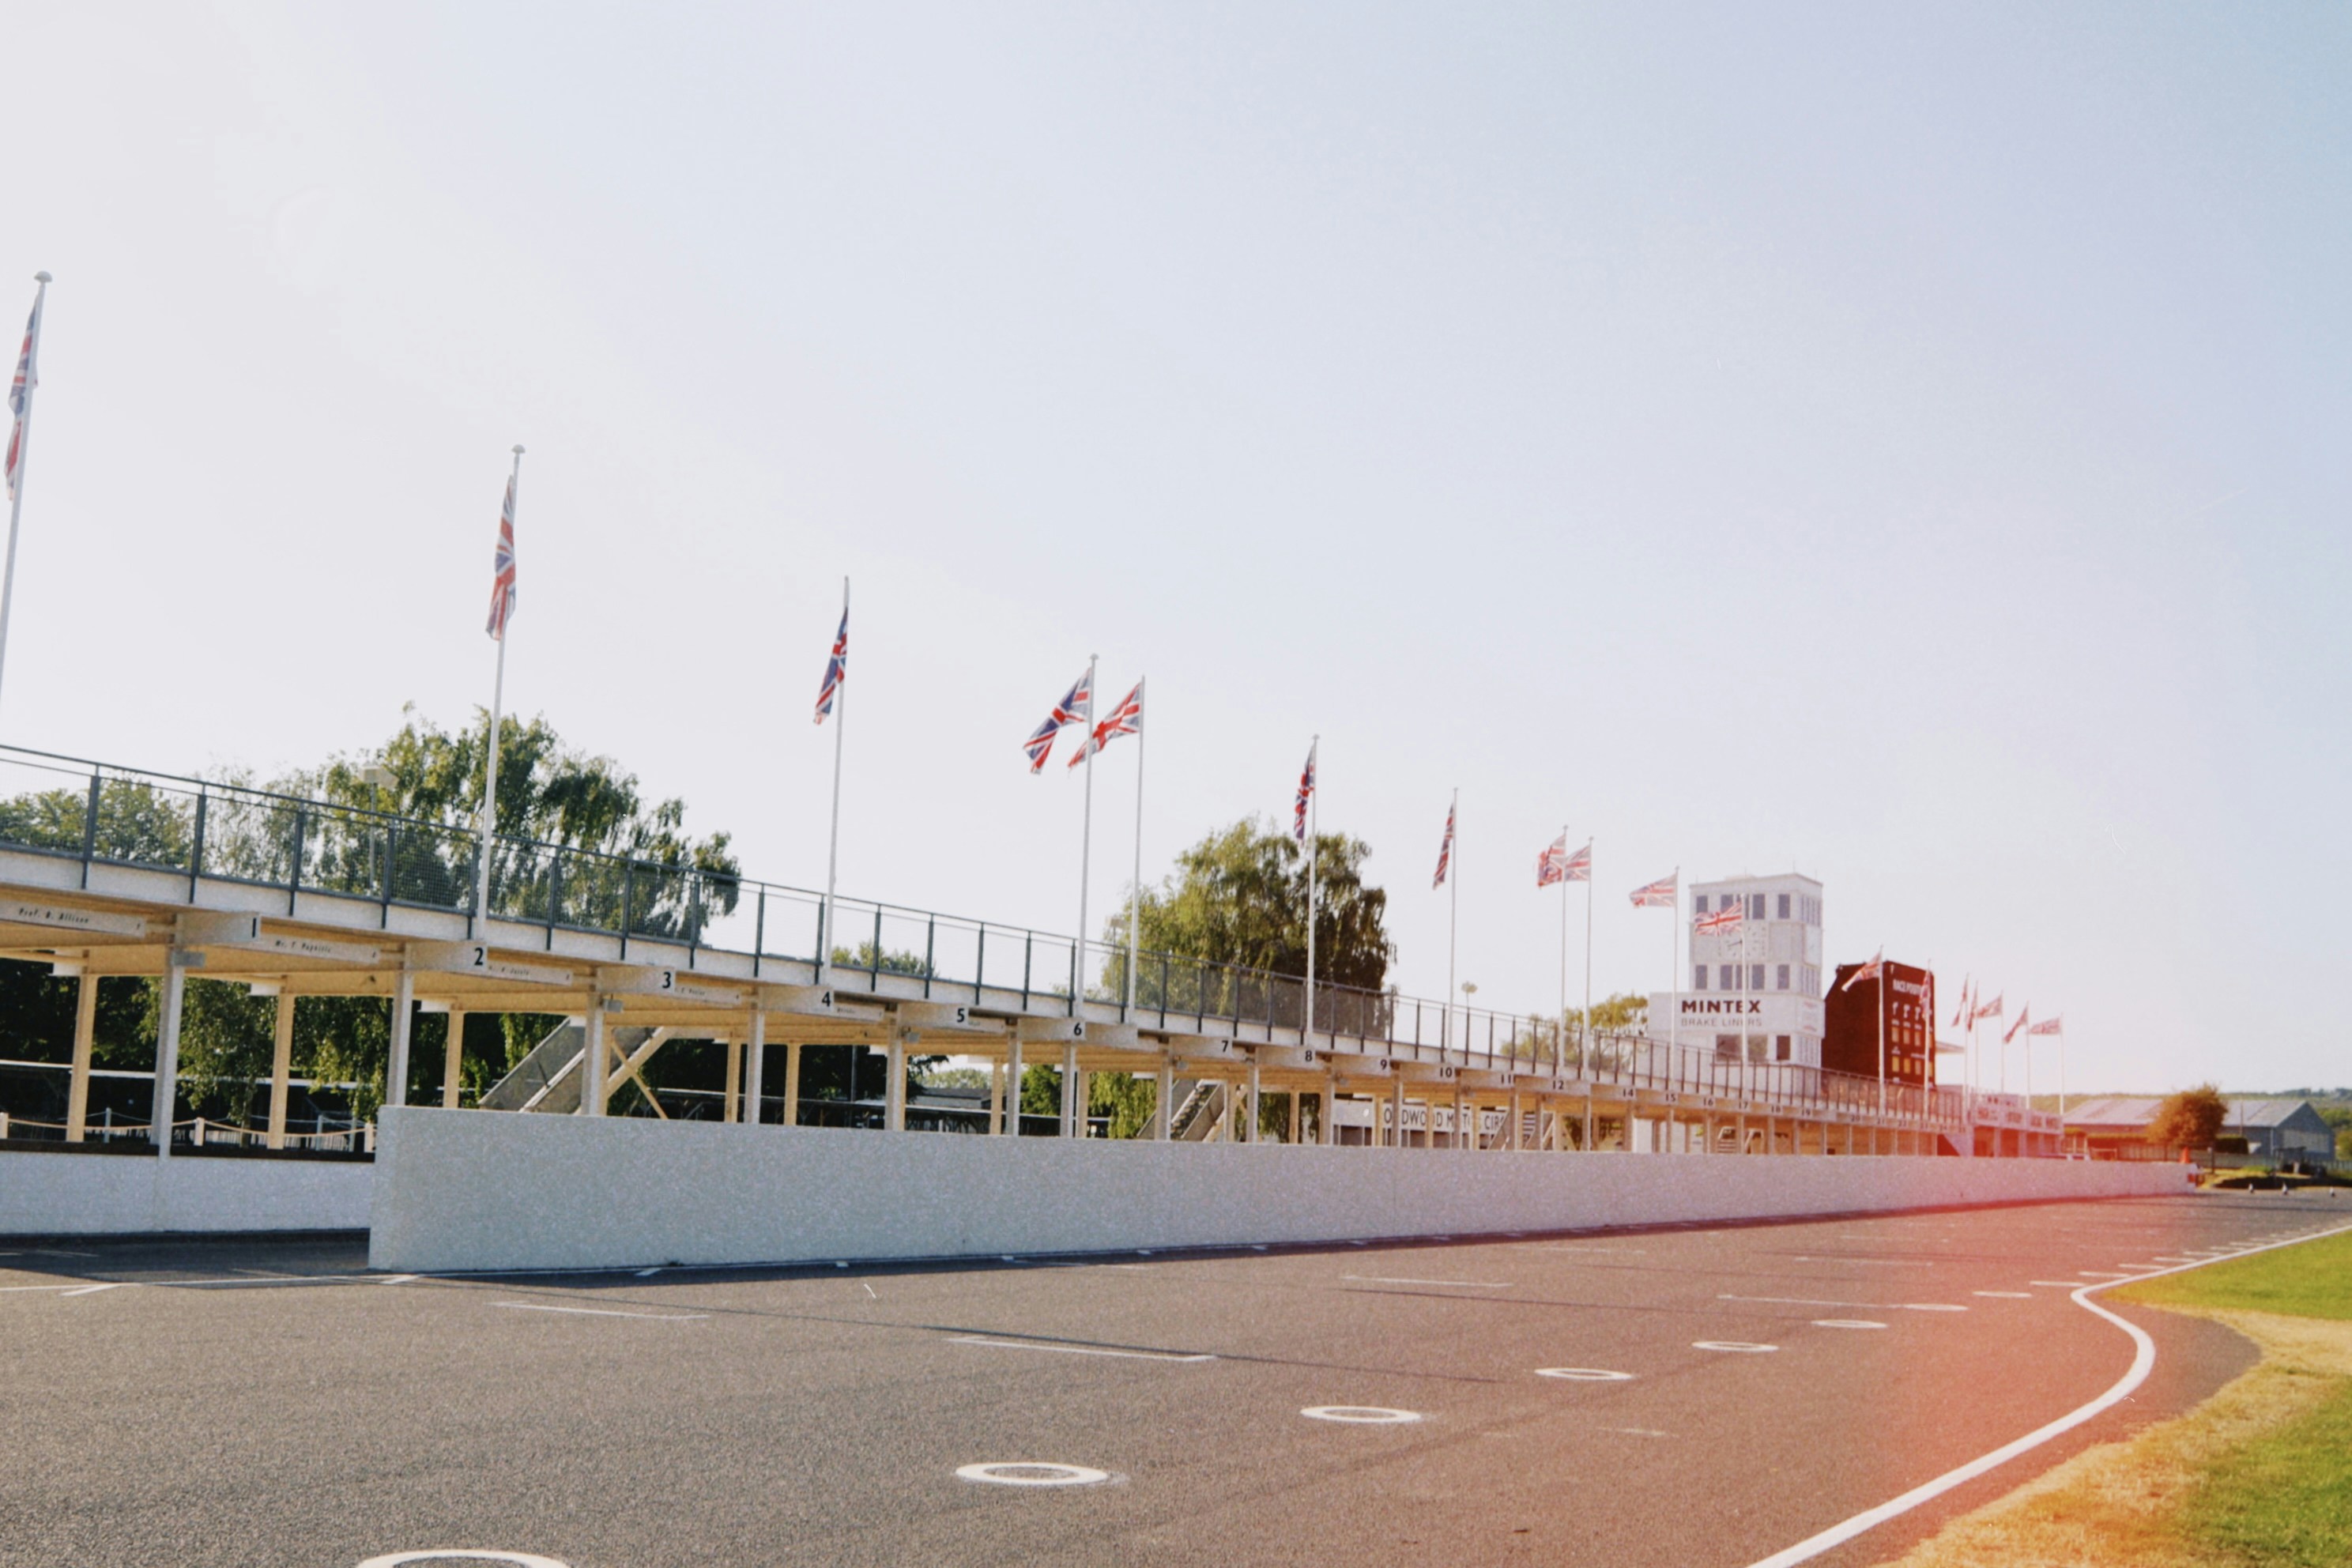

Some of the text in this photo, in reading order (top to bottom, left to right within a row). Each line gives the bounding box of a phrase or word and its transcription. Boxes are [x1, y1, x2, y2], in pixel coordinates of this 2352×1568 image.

[252, 918, 257, 938] 1
[474, 947, 484, 966] 2
[662, 971, 671, 989] 3
[822, 992, 831, 1007] 4
[1682, 1000, 1761, 1013] MINTEX
[957, 1008, 965, 1023] 5
[1682, 1018, 1762, 1027] BRAKE LINRS
[1073, 1023, 1082, 1036] 6
[1222, 1040, 1229, 1053] 7
[1305, 1050, 1313, 1062] 8
[1380, 1059, 1387, 1070] 9
[1440, 1067, 1453, 1078] 10
[1552, 1080, 1564, 1090] 12
[1623, 1089, 1634, 1098] 14
[1665, 1094, 1676, 1102] 15
[1703, 1098, 1713, 1106] 16
